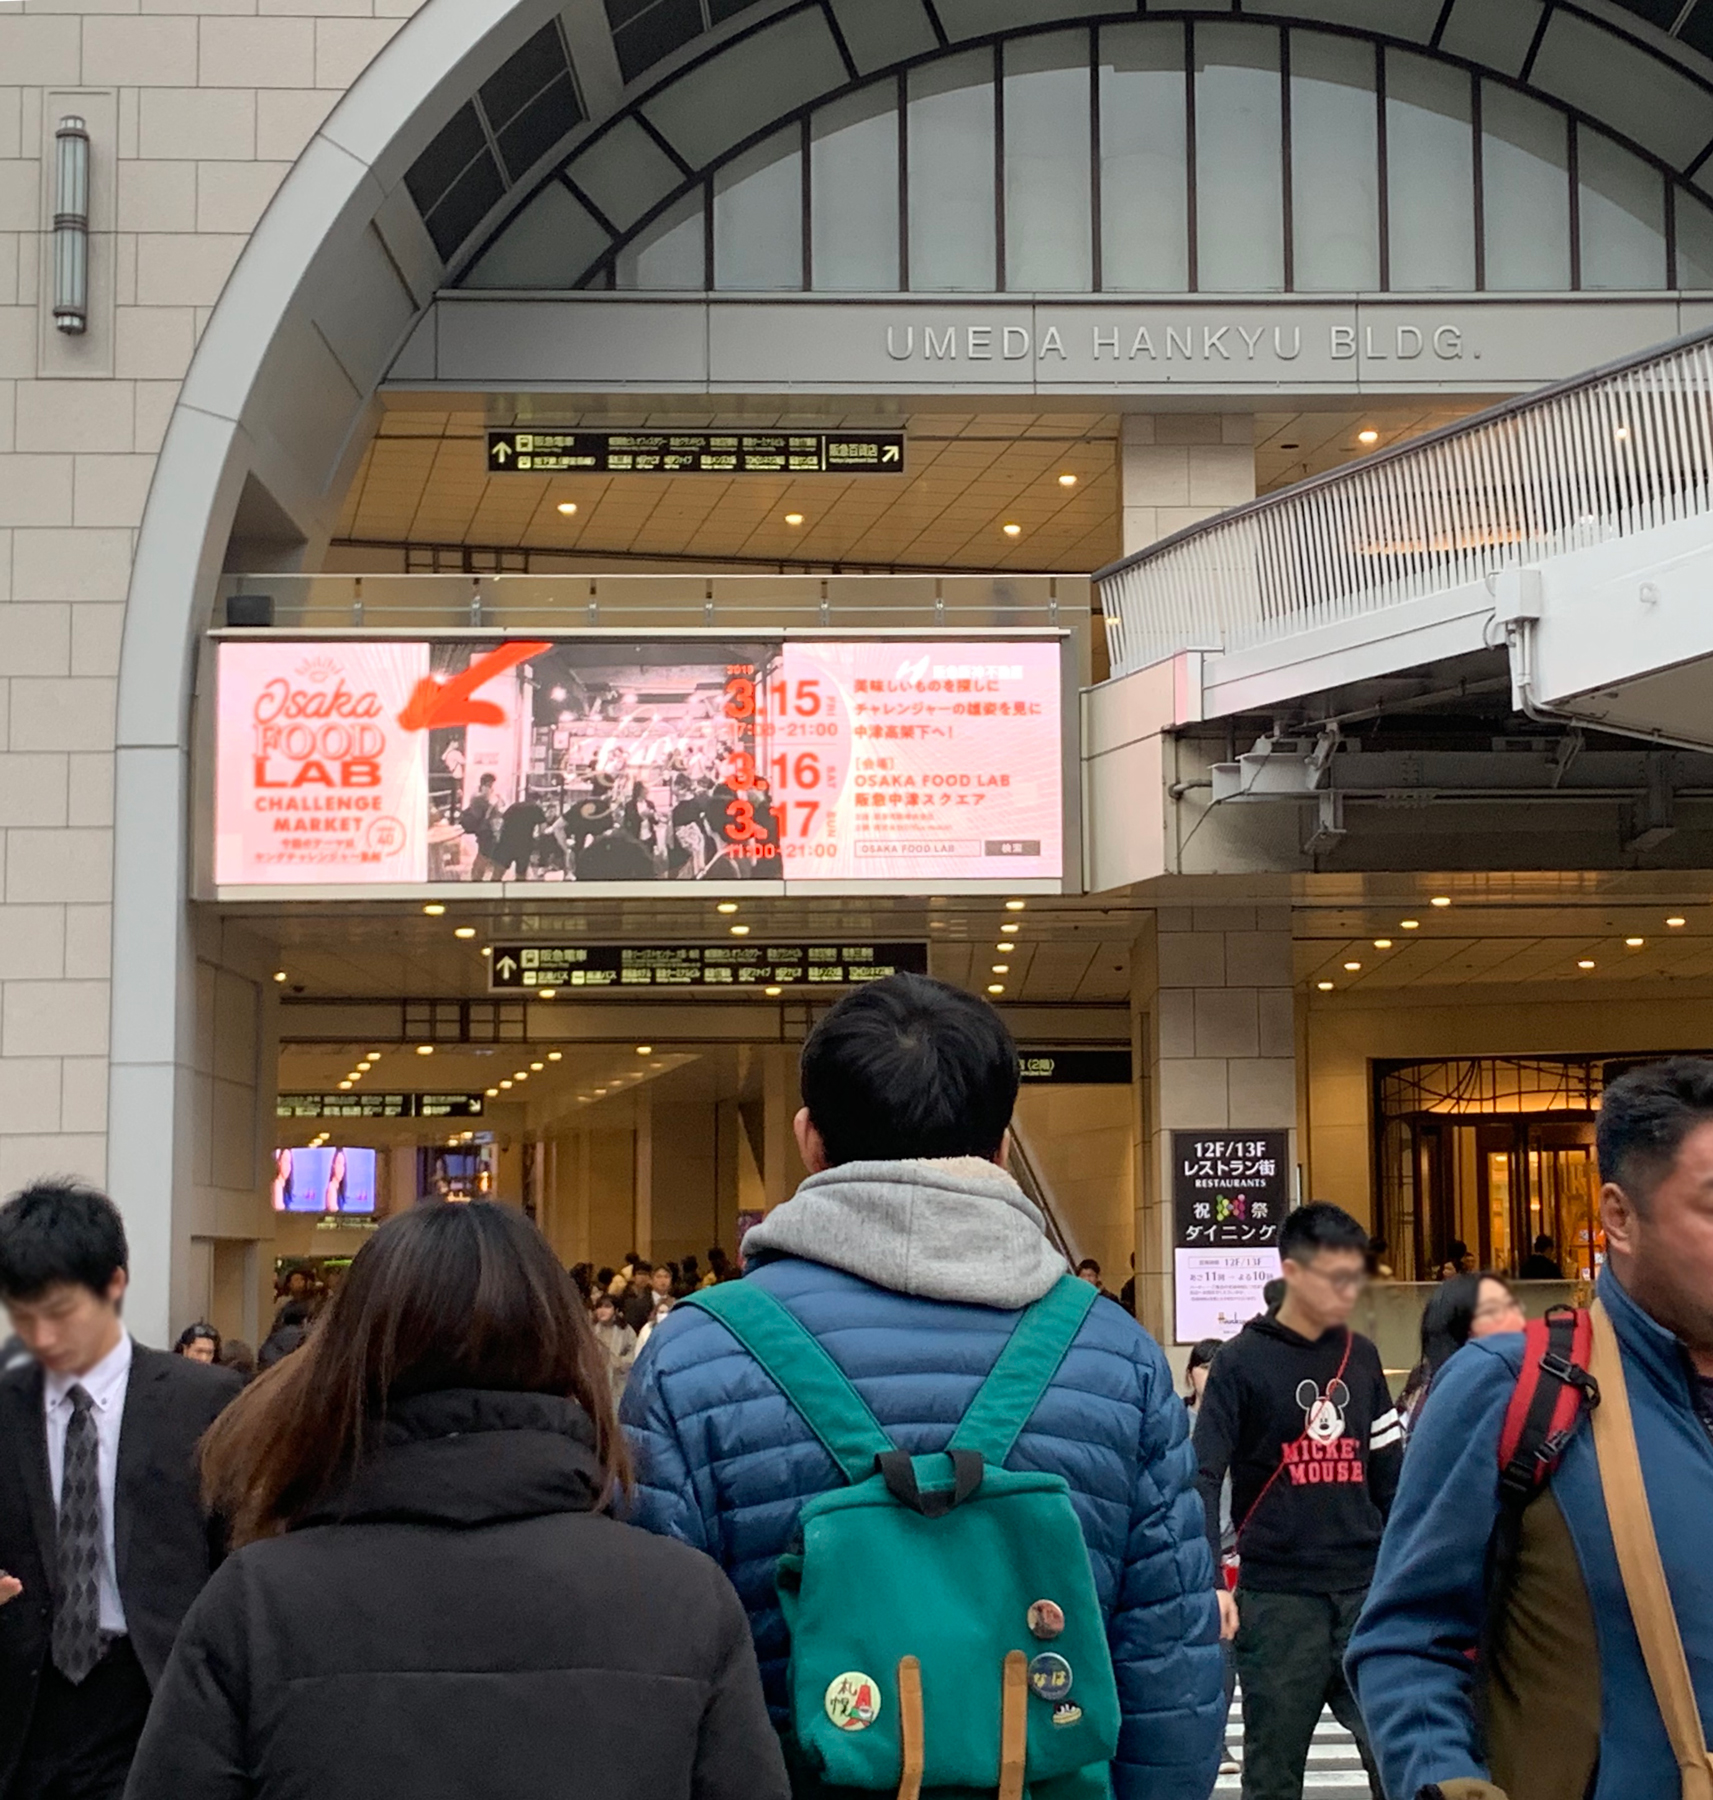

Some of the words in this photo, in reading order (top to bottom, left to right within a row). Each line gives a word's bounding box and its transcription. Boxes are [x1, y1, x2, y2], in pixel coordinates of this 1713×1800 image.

[886, 325, 1068, 361] UMEDA
[1093, 325, 1302, 361] HANKYU
[1329, 324, 1484, 361] BLDG.
[254, 677, 383, 725] Osaka
[724, 678, 821, 719] 3.15
[253, 722, 386, 761] FOOD
[254, 760, 382, 788] LAB
[724, 751, 821, 791] 3.16
[854, 774, 916, 787] OSAKA
[922, 774, 971, 787] FOOD
[977, 774, 1011, 787] LAB
[254, 796, 383, 811] CHALLENGE
[854, 793, 986, 807] 阪急中津スクエア
[273, 817, 363, 832] MARKET
[724, 800, 821, 840] 3.17
[861, 844, 898, 853] OSAKA
[901, 844, 931, 853] FOOD
[934, 844, 955, 853] LAB
[1194, 1141, 1266, 1158] 12F/13F
[1184, 1160, 1275, 1176] レストラン街
[1195, 1179, 1266, 1188] RESTAURANTS
[1193, 1202, 1211, 1219] 祝
[1251, 1202, 1269, 1219] 祭
[1185, 1225, 1277, 1241] ダイニング
[1281, 1437, 1361, 1463] MICKE
[1288, 1461, 1363, 1486] MOUSE
